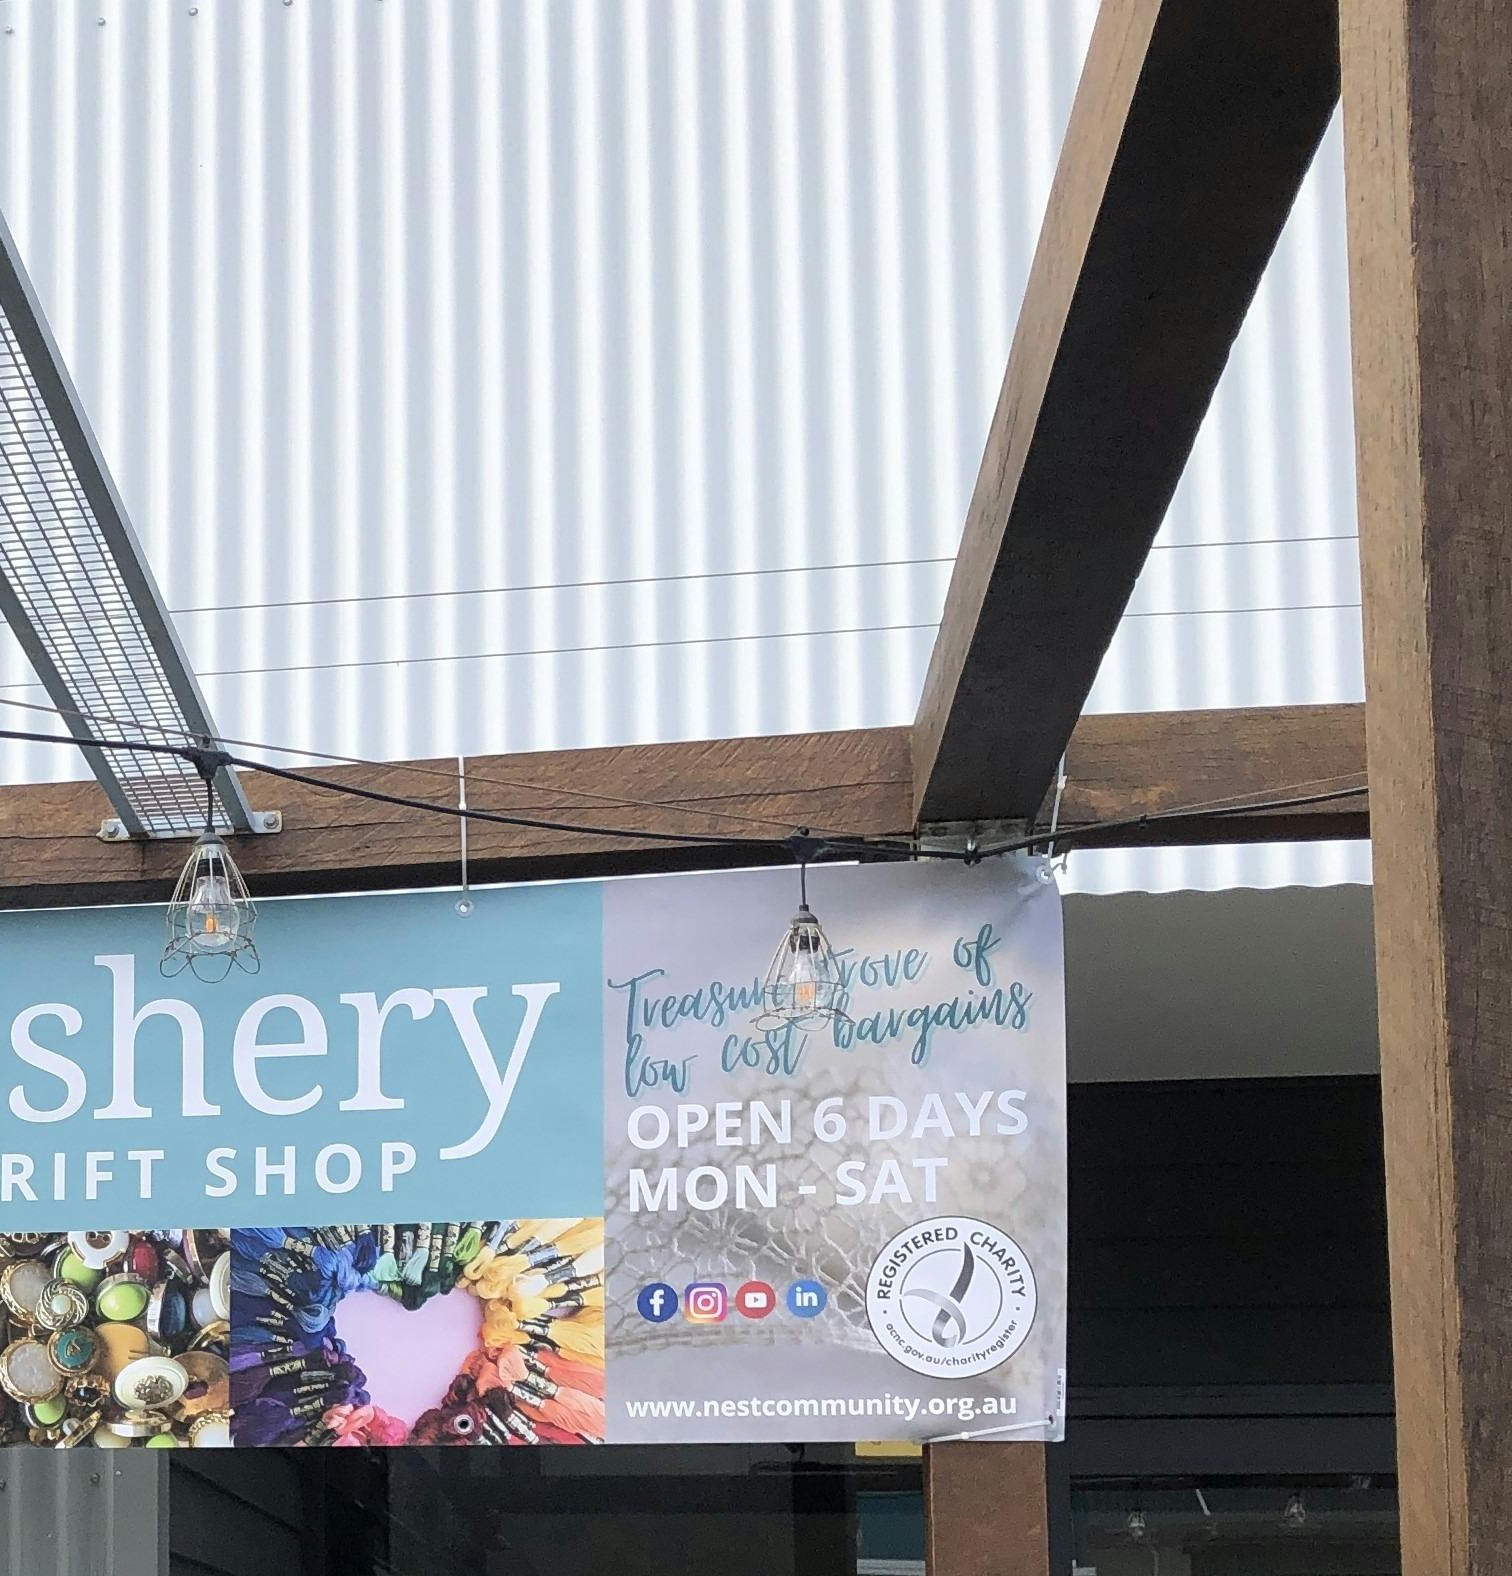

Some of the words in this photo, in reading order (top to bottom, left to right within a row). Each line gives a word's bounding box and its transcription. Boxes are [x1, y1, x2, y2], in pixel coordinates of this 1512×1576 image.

[953, 923, 1001, 987] of
[625, 1033, 698, 1098] low
[721, 1016, 811, 1075] cost
[832, 982, 1033, 1065] bargains
[626, 1099, 792, 1150] OPEN
[813, 1096, 847, 1143] 6
[868, 1089, 1029, 1142] DAYS
[204, 1141, 417, 1198] SHOP
[628, 1163, 778, 1213] MON
[835, 1157, 949, 1206] SAT
[876, 1226, 959, 1300] REGISTERED
[969, 1231, 1027, 1298] CHARITY
[885, 1318, 1019, 1367] acnc.gov.au/charityregister
[625, 1392, 1018, 1422] www.nestcommunity.org.au
